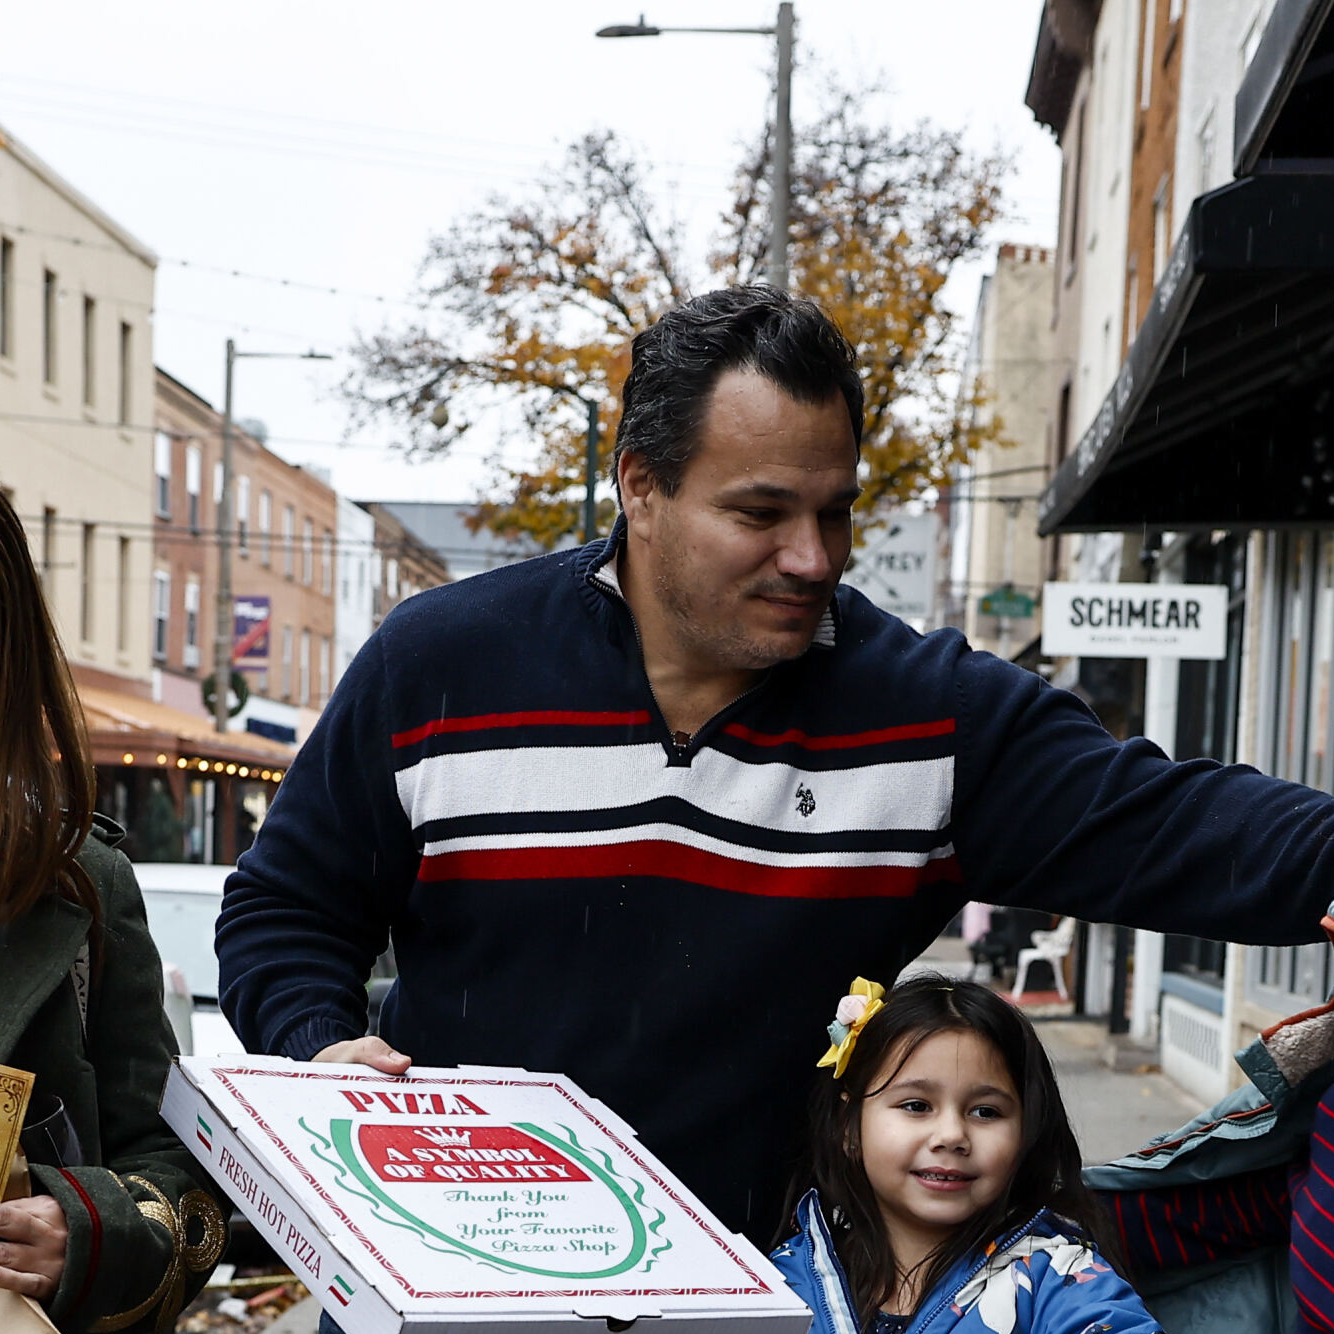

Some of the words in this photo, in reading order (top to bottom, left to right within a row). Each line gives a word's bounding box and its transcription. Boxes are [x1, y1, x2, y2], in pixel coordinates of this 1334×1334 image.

[1070, 596, 1200, 629] SCHMEAR
[338, 1090, 491, 1115] PIZZA
[385, 1147, 412, 1162] A
[411, 1147, 547, 1163] SYMBOL
[383, 1164, 426, 1179] OF
[432, 1163, 572, 1182] QUALITY
[443, 1190, 518, 1202] Thank
[521, 1190, 570, 1206] You
[219, 1146, 259, 1206] FRESH
[257, 1191, 287, 1235] HOT
[285, 1223, 323, 1281] PIZZA
[487, 1207, 549, 1223] from
[456, 1223, 517, 1240] Your
[519, 1222, 618, 1235] Favorite
[491, 1239, 558, 1253] Pizza
[562, 1239, 619, 1256] Shop
